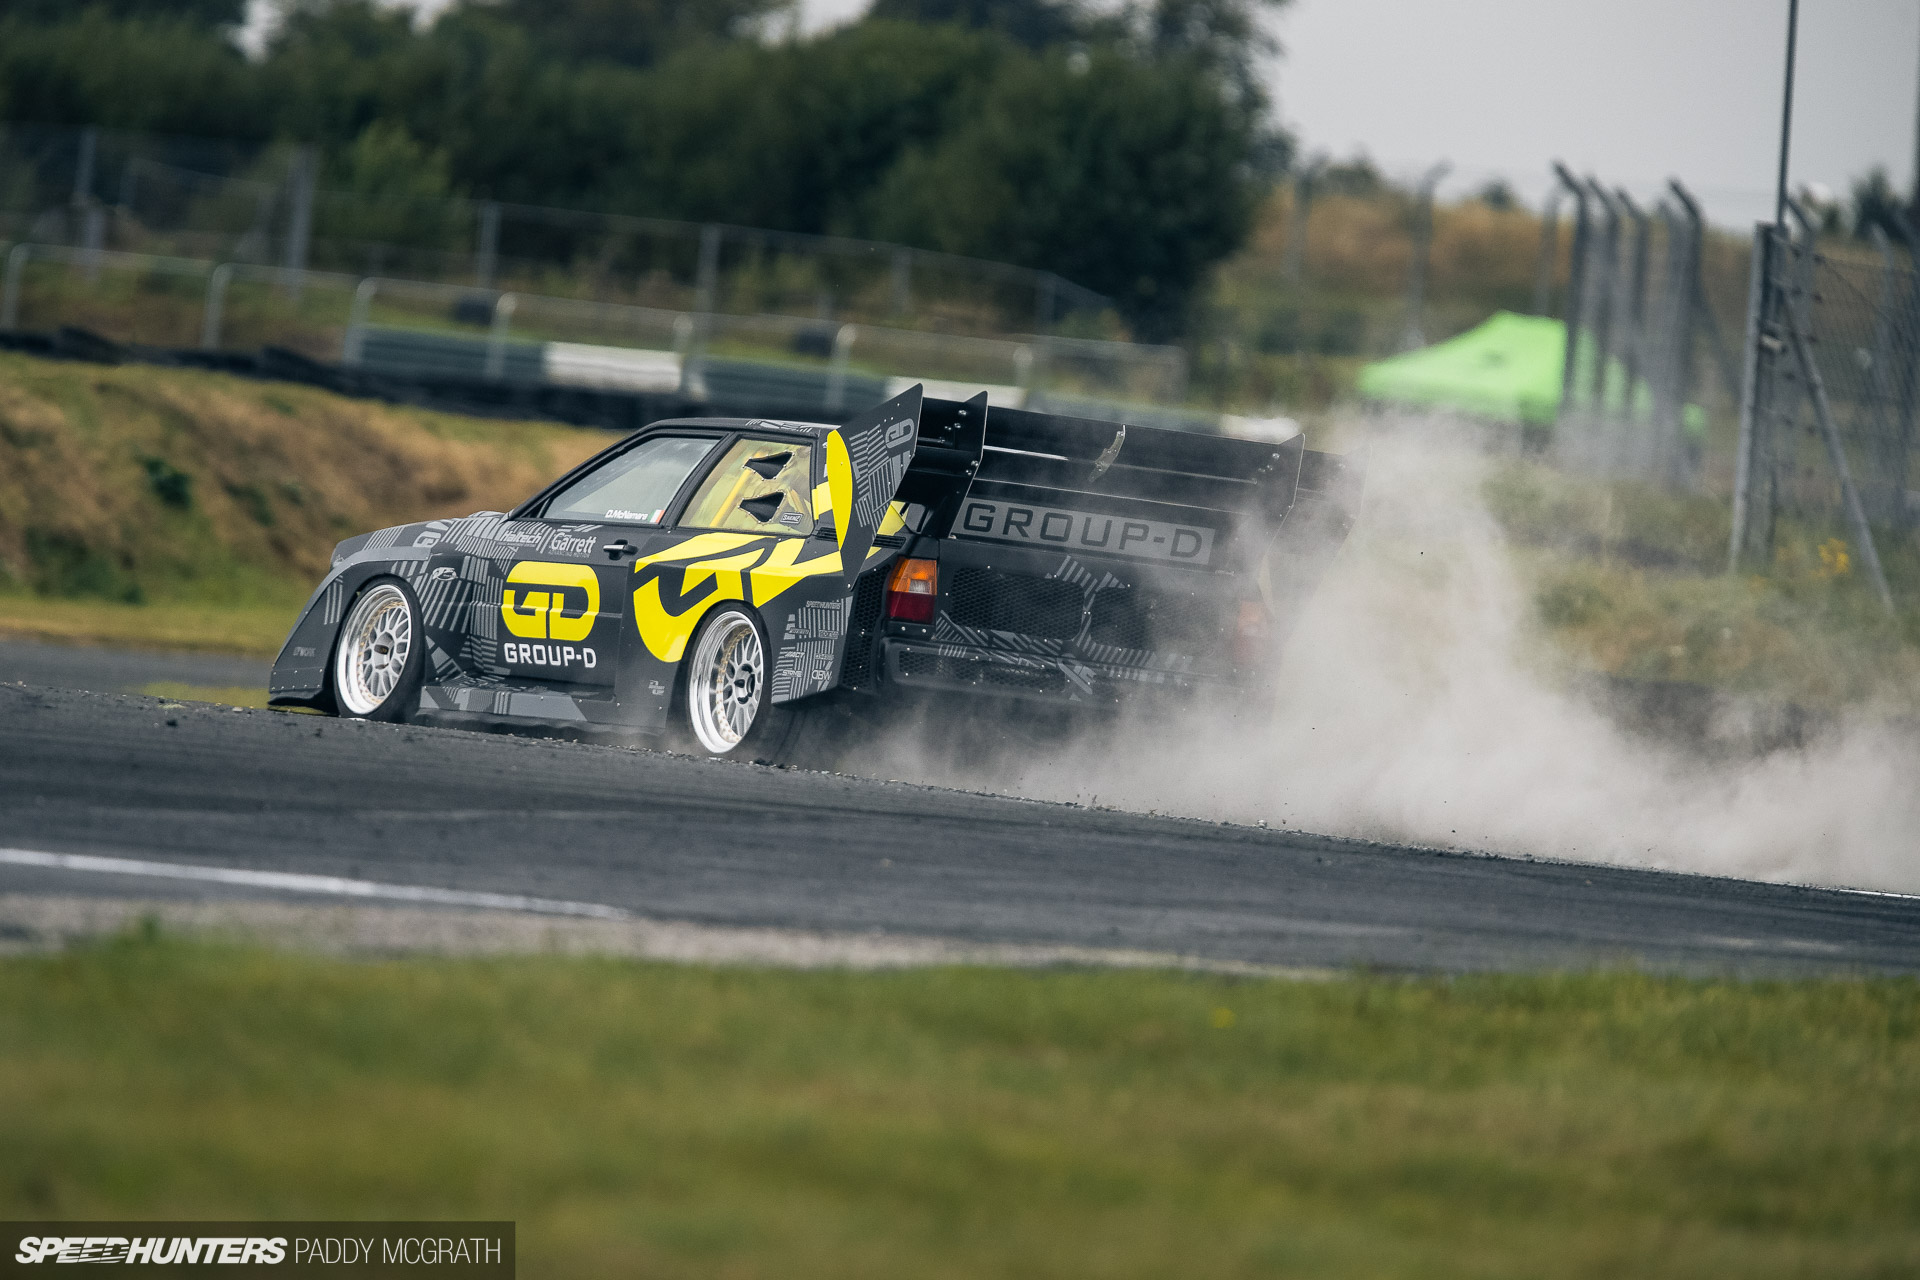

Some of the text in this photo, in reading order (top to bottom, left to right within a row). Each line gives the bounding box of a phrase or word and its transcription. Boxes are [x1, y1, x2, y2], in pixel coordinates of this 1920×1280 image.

[500, 530, 542, 544] Haltech
[963, 502, 1203, 558] GROUP-D
[551, 532, 597, 554] Garrett
[503, 642, 597, 669] GROUP-D
